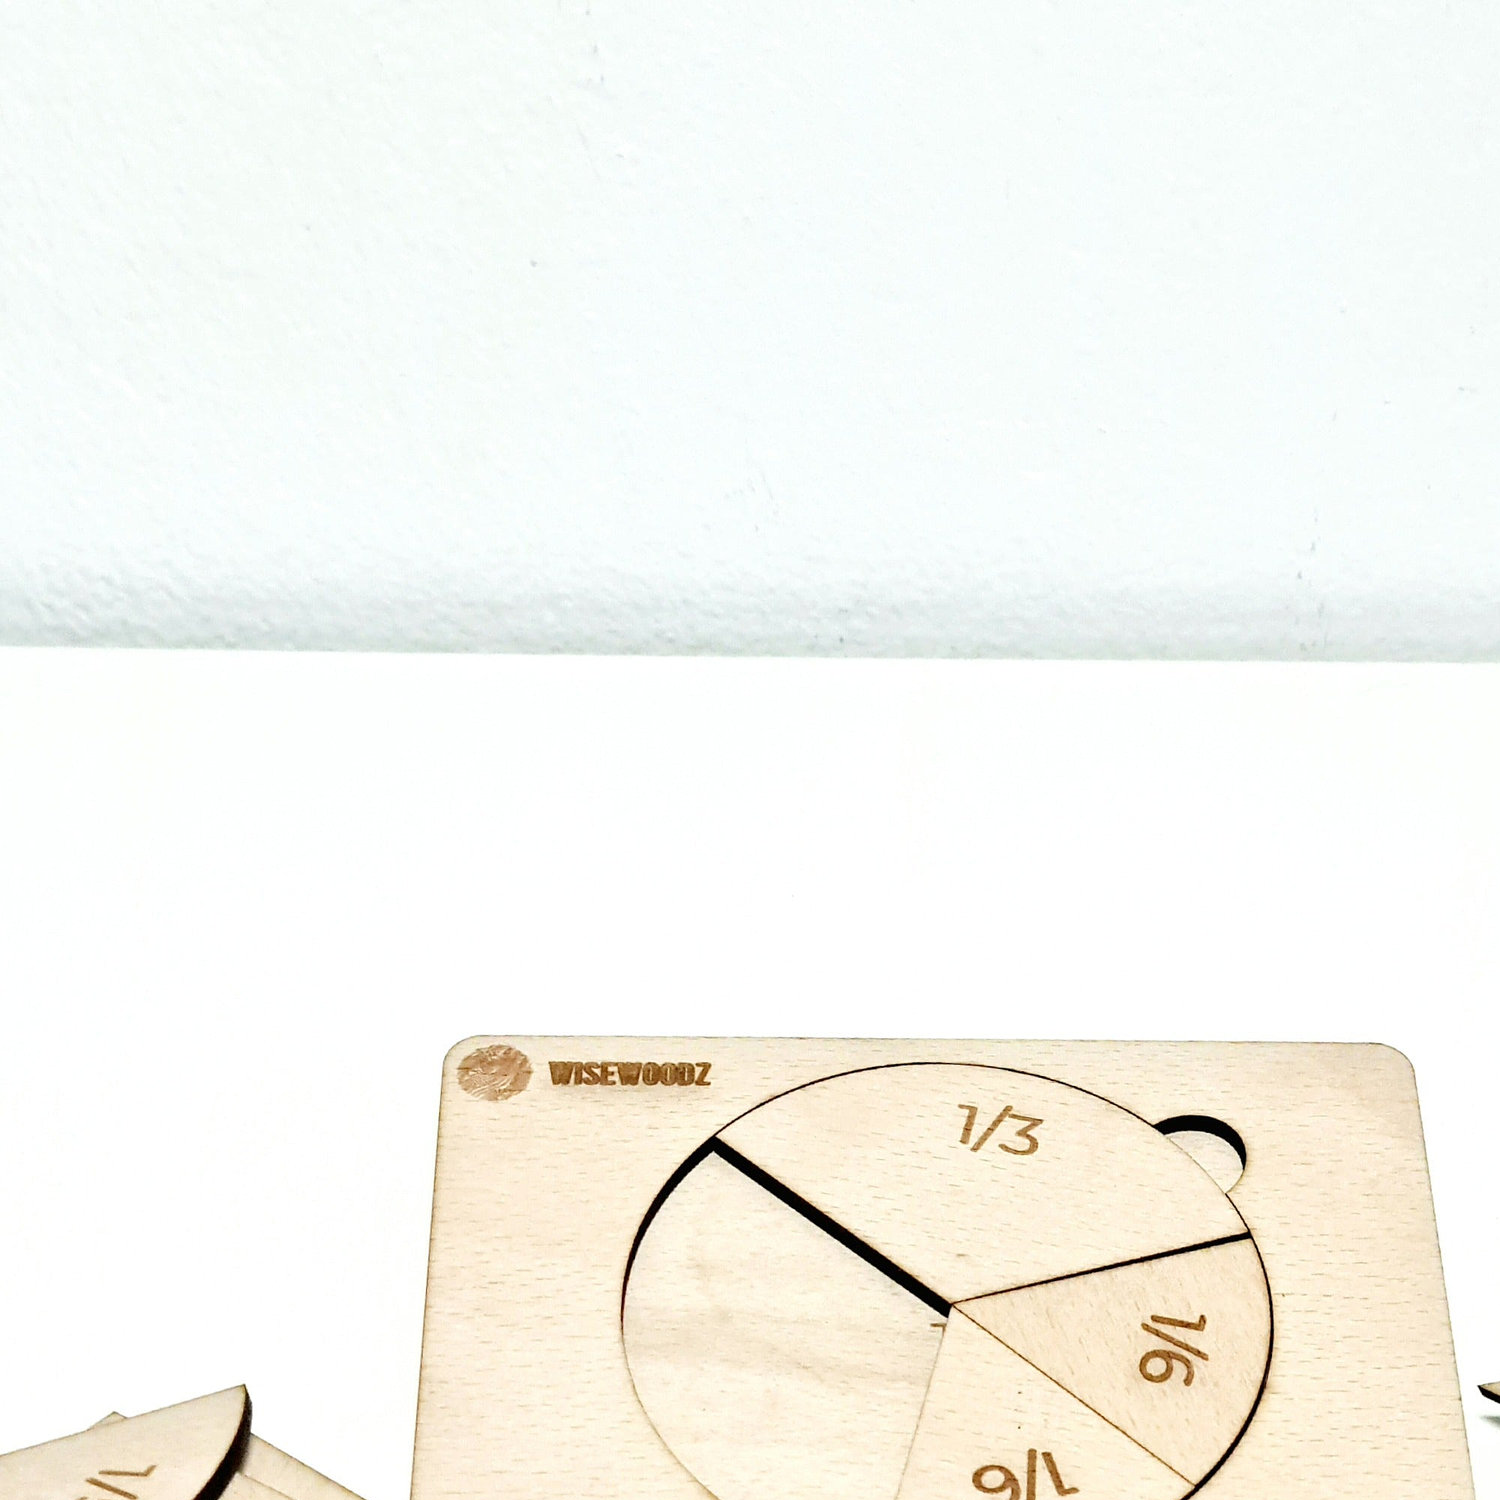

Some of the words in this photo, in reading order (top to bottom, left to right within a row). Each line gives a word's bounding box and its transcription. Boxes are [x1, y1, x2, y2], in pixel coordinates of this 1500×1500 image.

[548, 1061, 712, 1087] WISEWOODZ
[957, 1103, 1045, 1156] 1/3
[1138, 1314, 1210, 1387] 1/6
